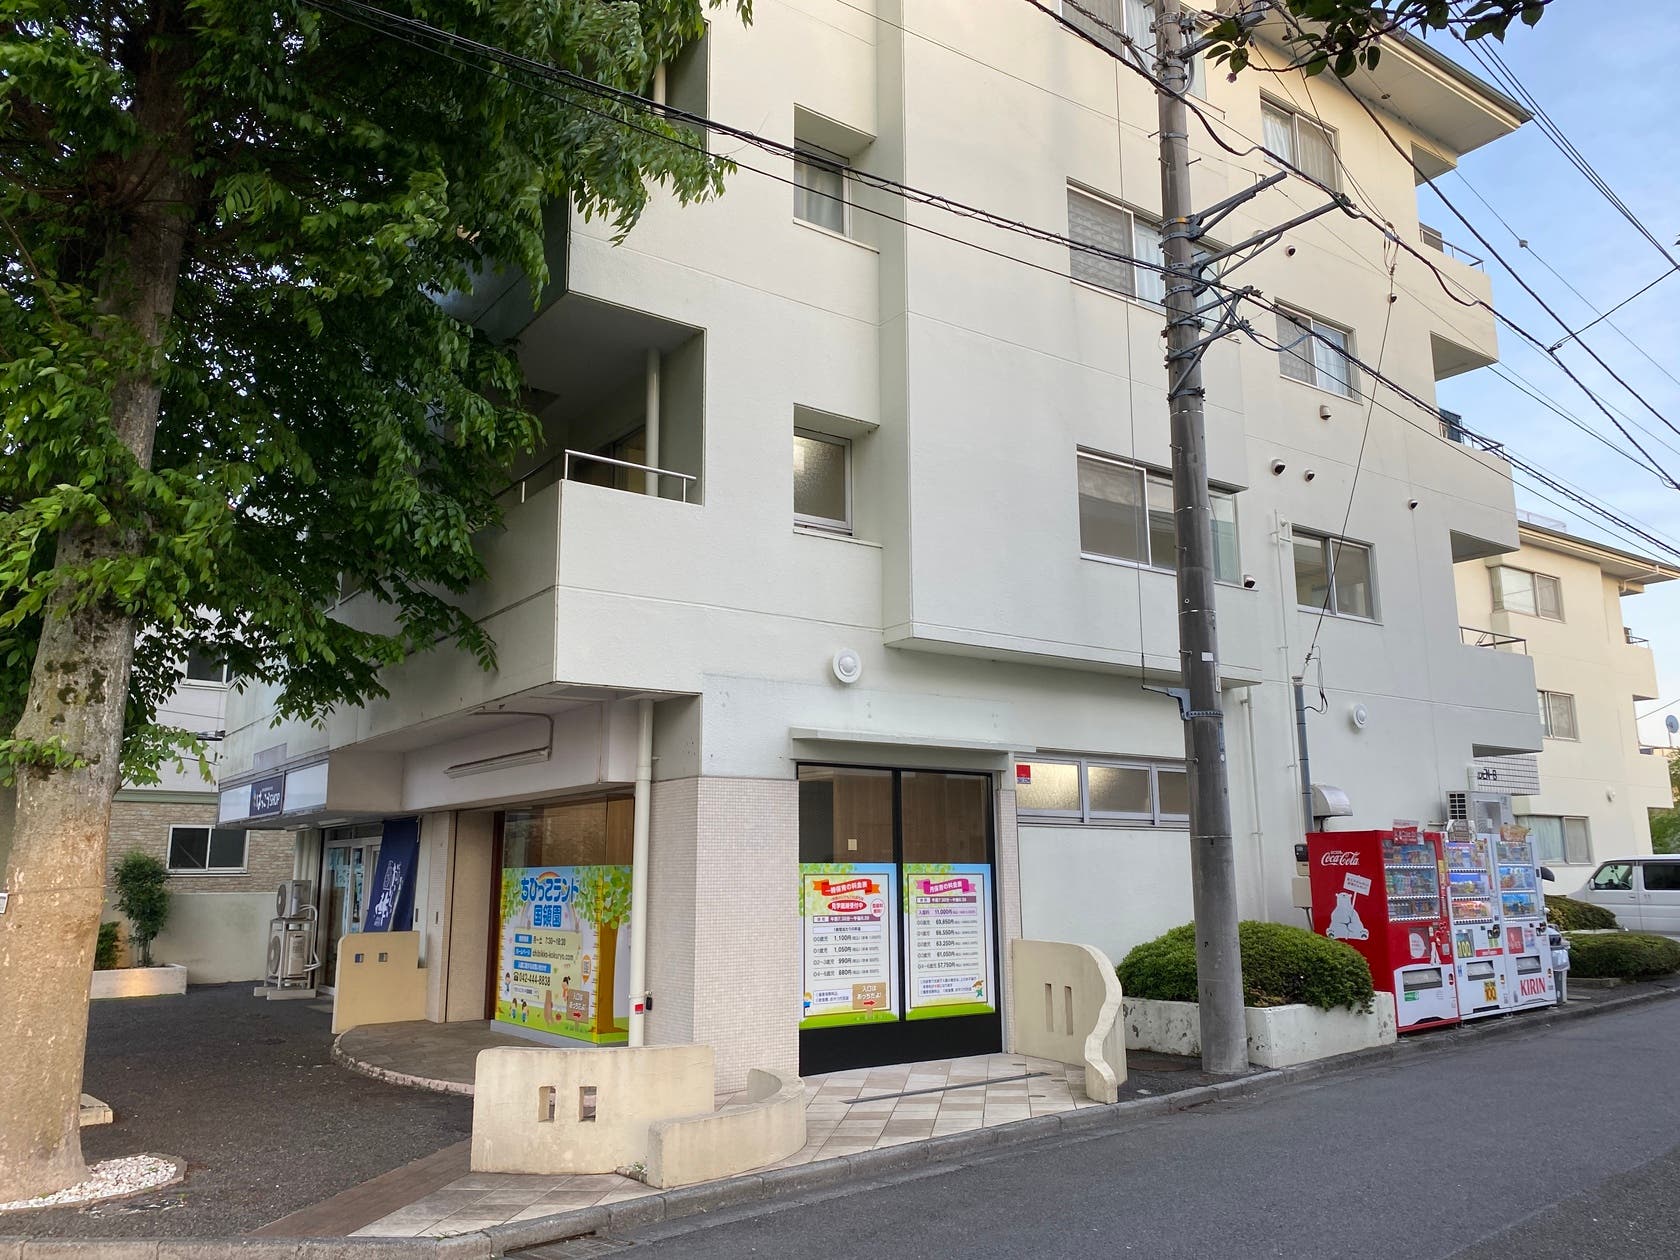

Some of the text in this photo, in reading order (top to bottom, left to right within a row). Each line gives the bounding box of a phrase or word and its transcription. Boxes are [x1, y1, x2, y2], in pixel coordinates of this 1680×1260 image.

[521, 877, 580, 903] ちびっこランド
[1520, 977, 1546, 996] KIRIN
